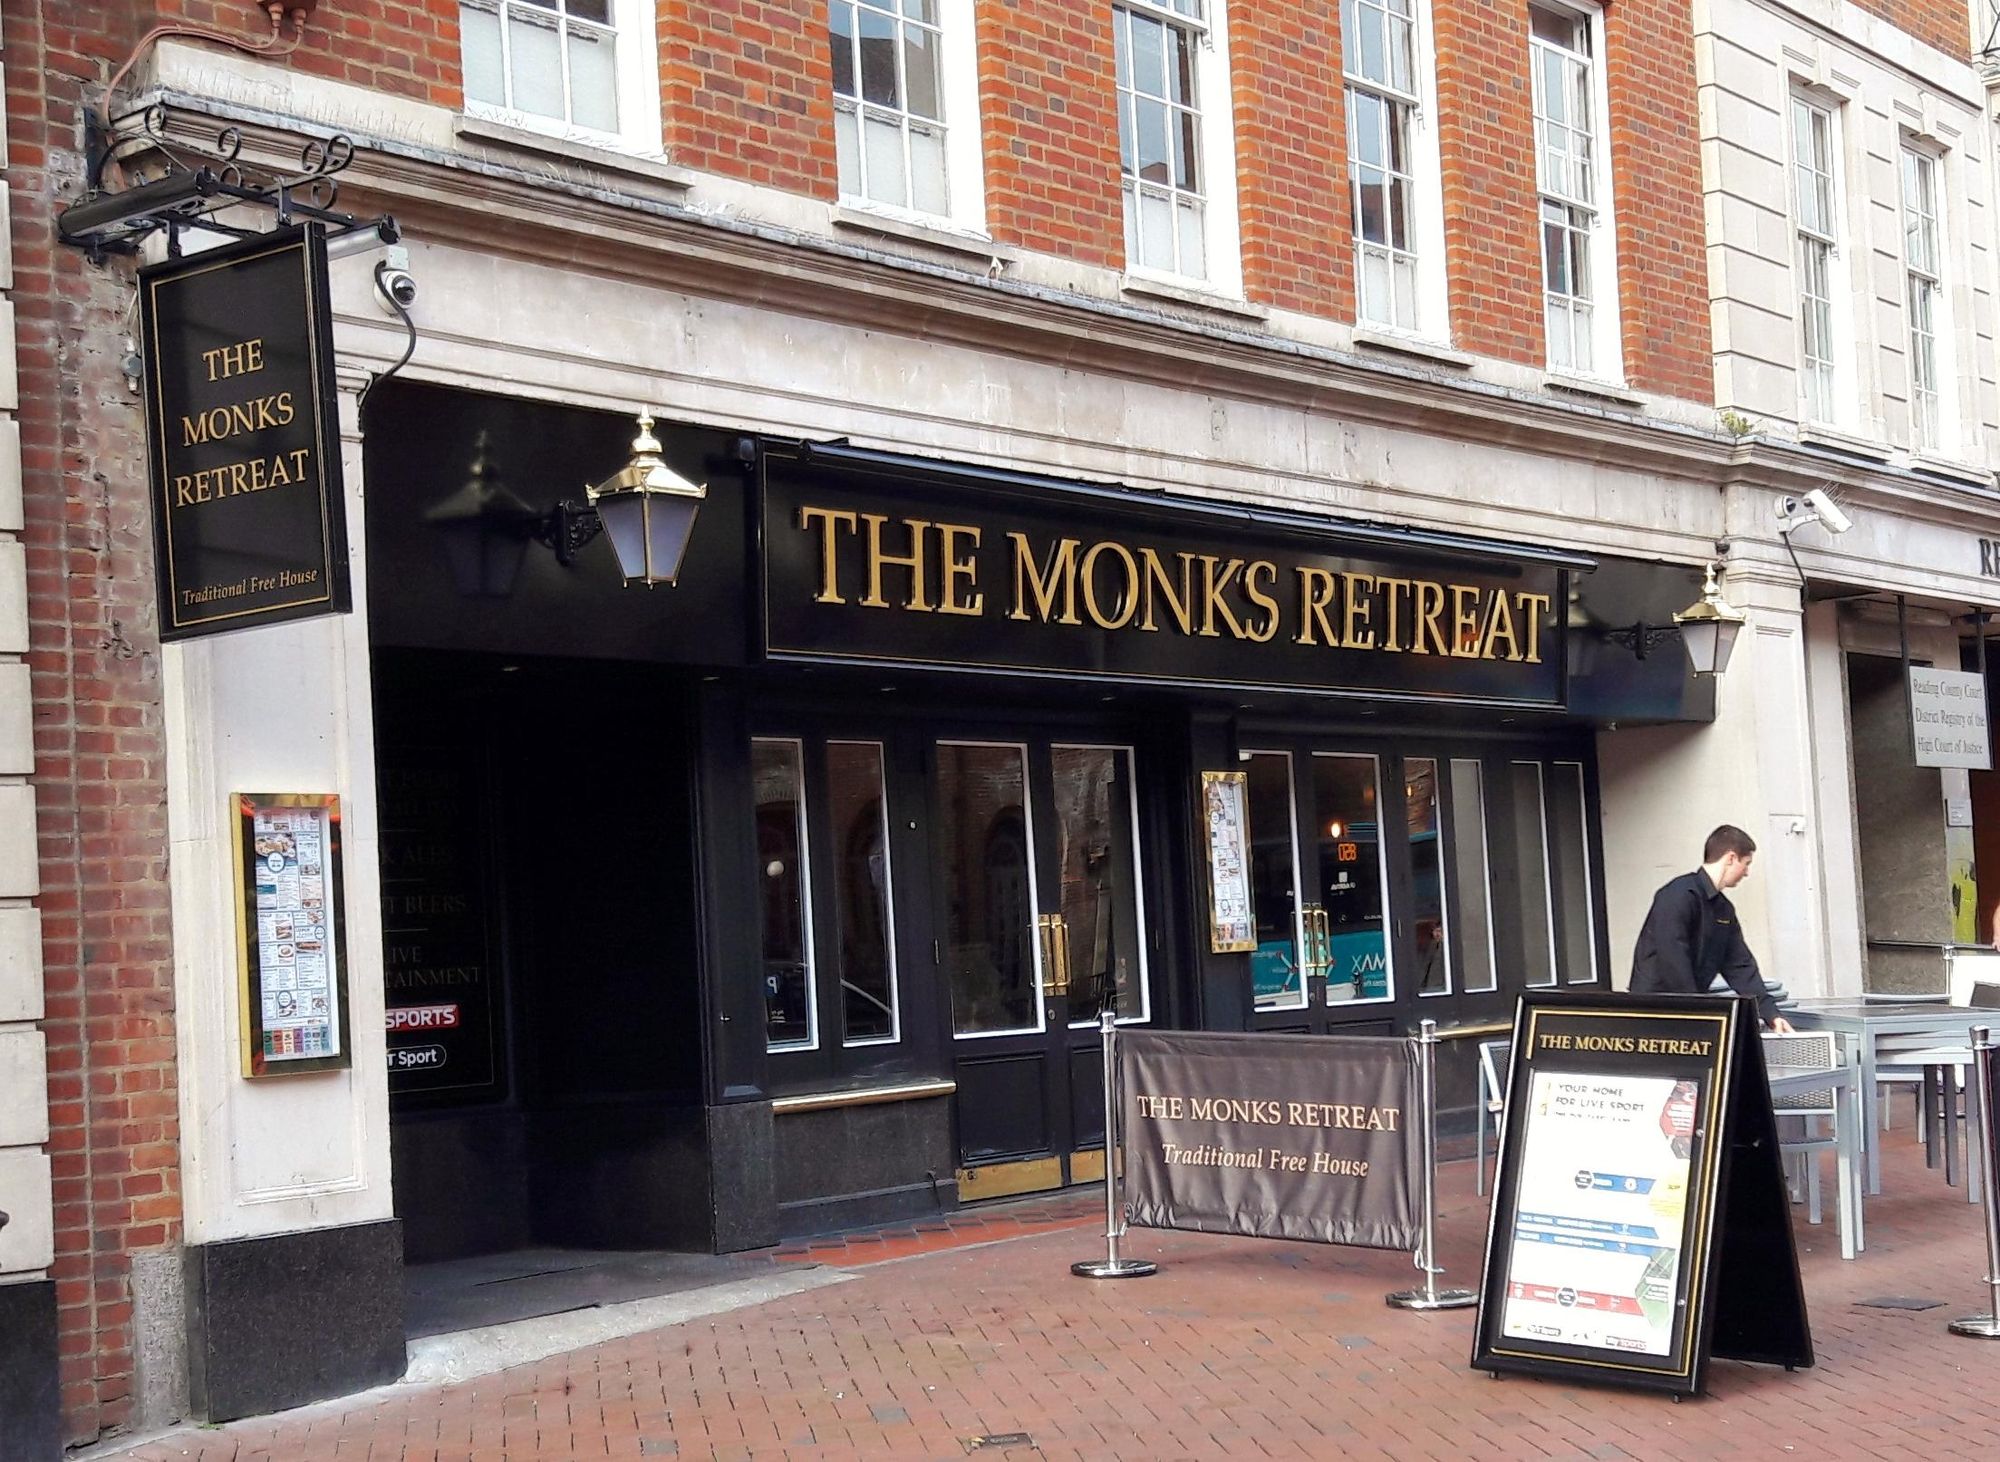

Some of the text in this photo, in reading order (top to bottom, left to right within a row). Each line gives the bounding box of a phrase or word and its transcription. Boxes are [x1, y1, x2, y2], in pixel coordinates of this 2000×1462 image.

[202, 338, 264, 382] THE
[181, 392, 296, 447] MONKS
[174, 449, 310, 508] RETREAT
[182, 567, 319, 606] Traditional Free House
[801, 505, 1550, 664] THE MONKS RETREAT
[1967, 713, 1974, 726] of
[1954, 740, 1962, 754] of
[388, 946, 422, 963] IVE
[385, 1007, 456, 1029] SPORTS
[1540, 1034, 1712, 1056] THE MONKS RETREAT
[387, 1049, 437, 1067] T Sport
[1559, 1083, 1624, 1097] YOUR HOME
[1137, 1095, 1400, 1132] THE MONKS RETREAT
[1555, 1096, 1645, 1111] FOR LIVE SPORT
[1162, 1143, 1370, 1177] Traditional Free House
